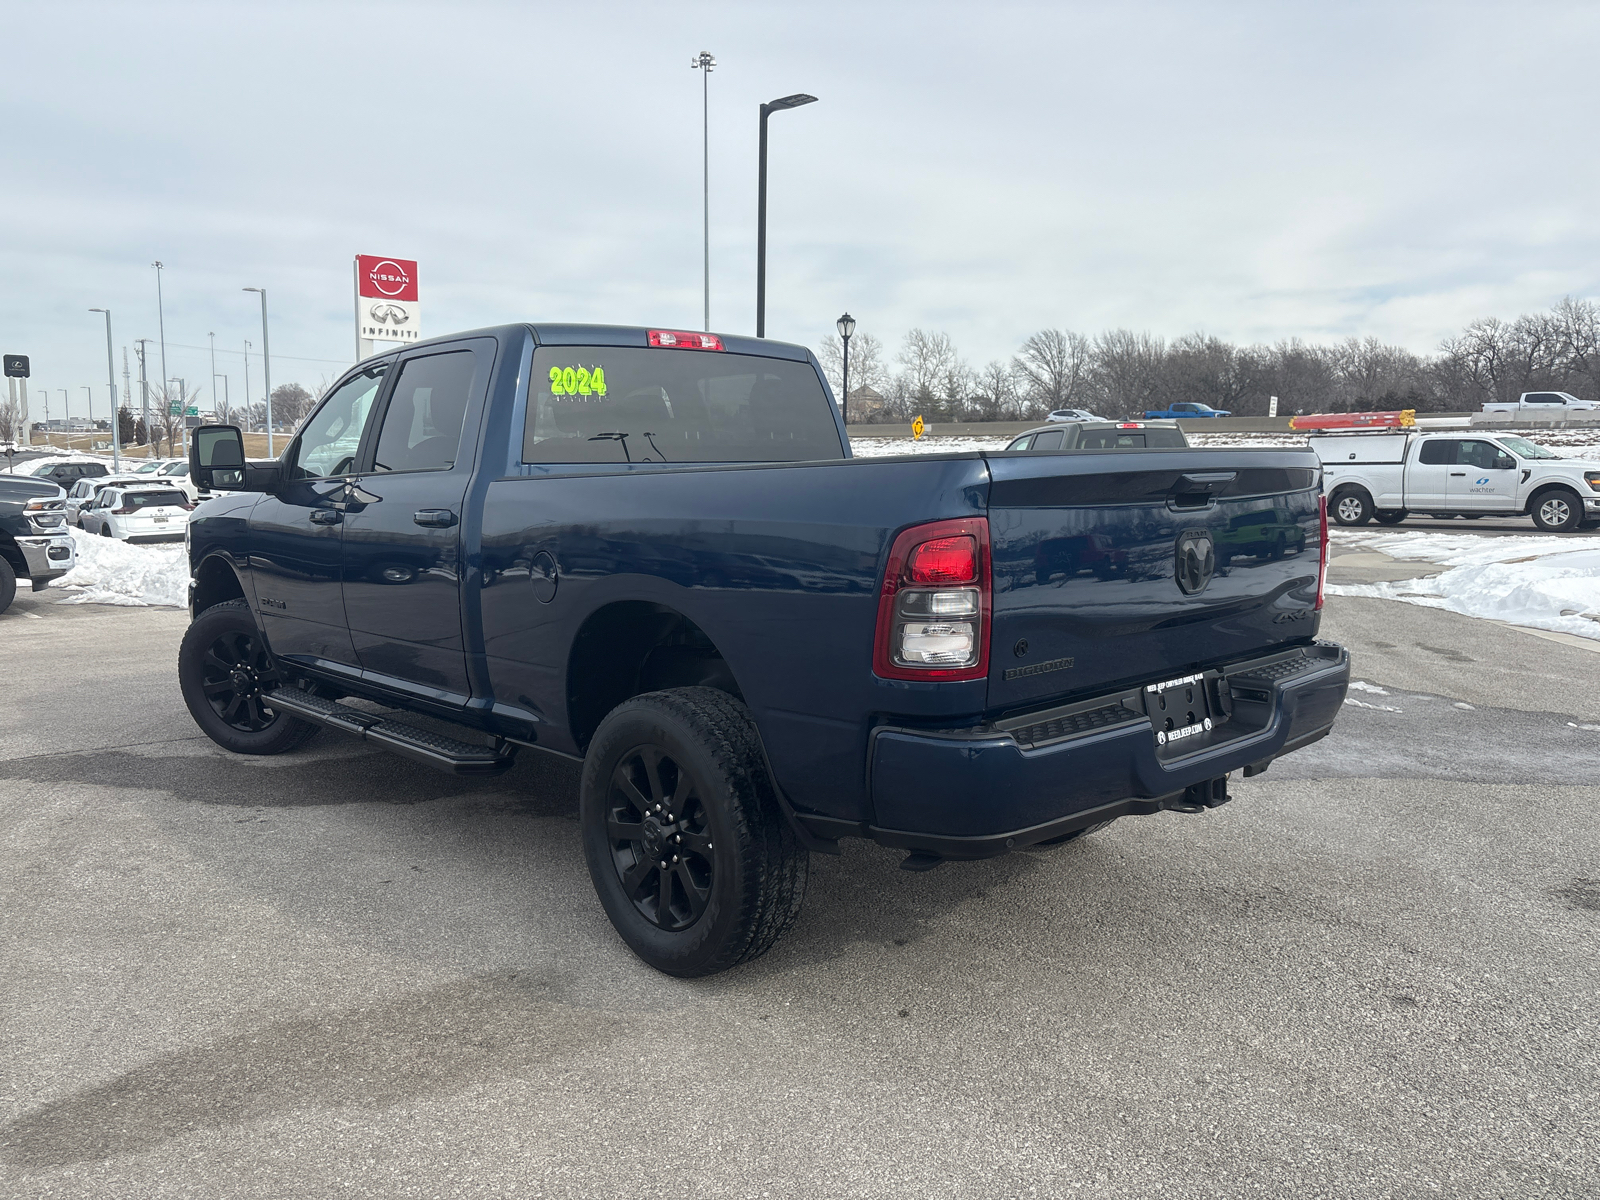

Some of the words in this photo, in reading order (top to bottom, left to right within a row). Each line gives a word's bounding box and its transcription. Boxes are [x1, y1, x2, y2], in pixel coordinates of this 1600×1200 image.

[369, 273, 409, 283] NISSAN
[363, 327, 418, 338] INFINITI
[549, 366, 607, 396] 2024
[1186, 530, 1208, 538] RAM
